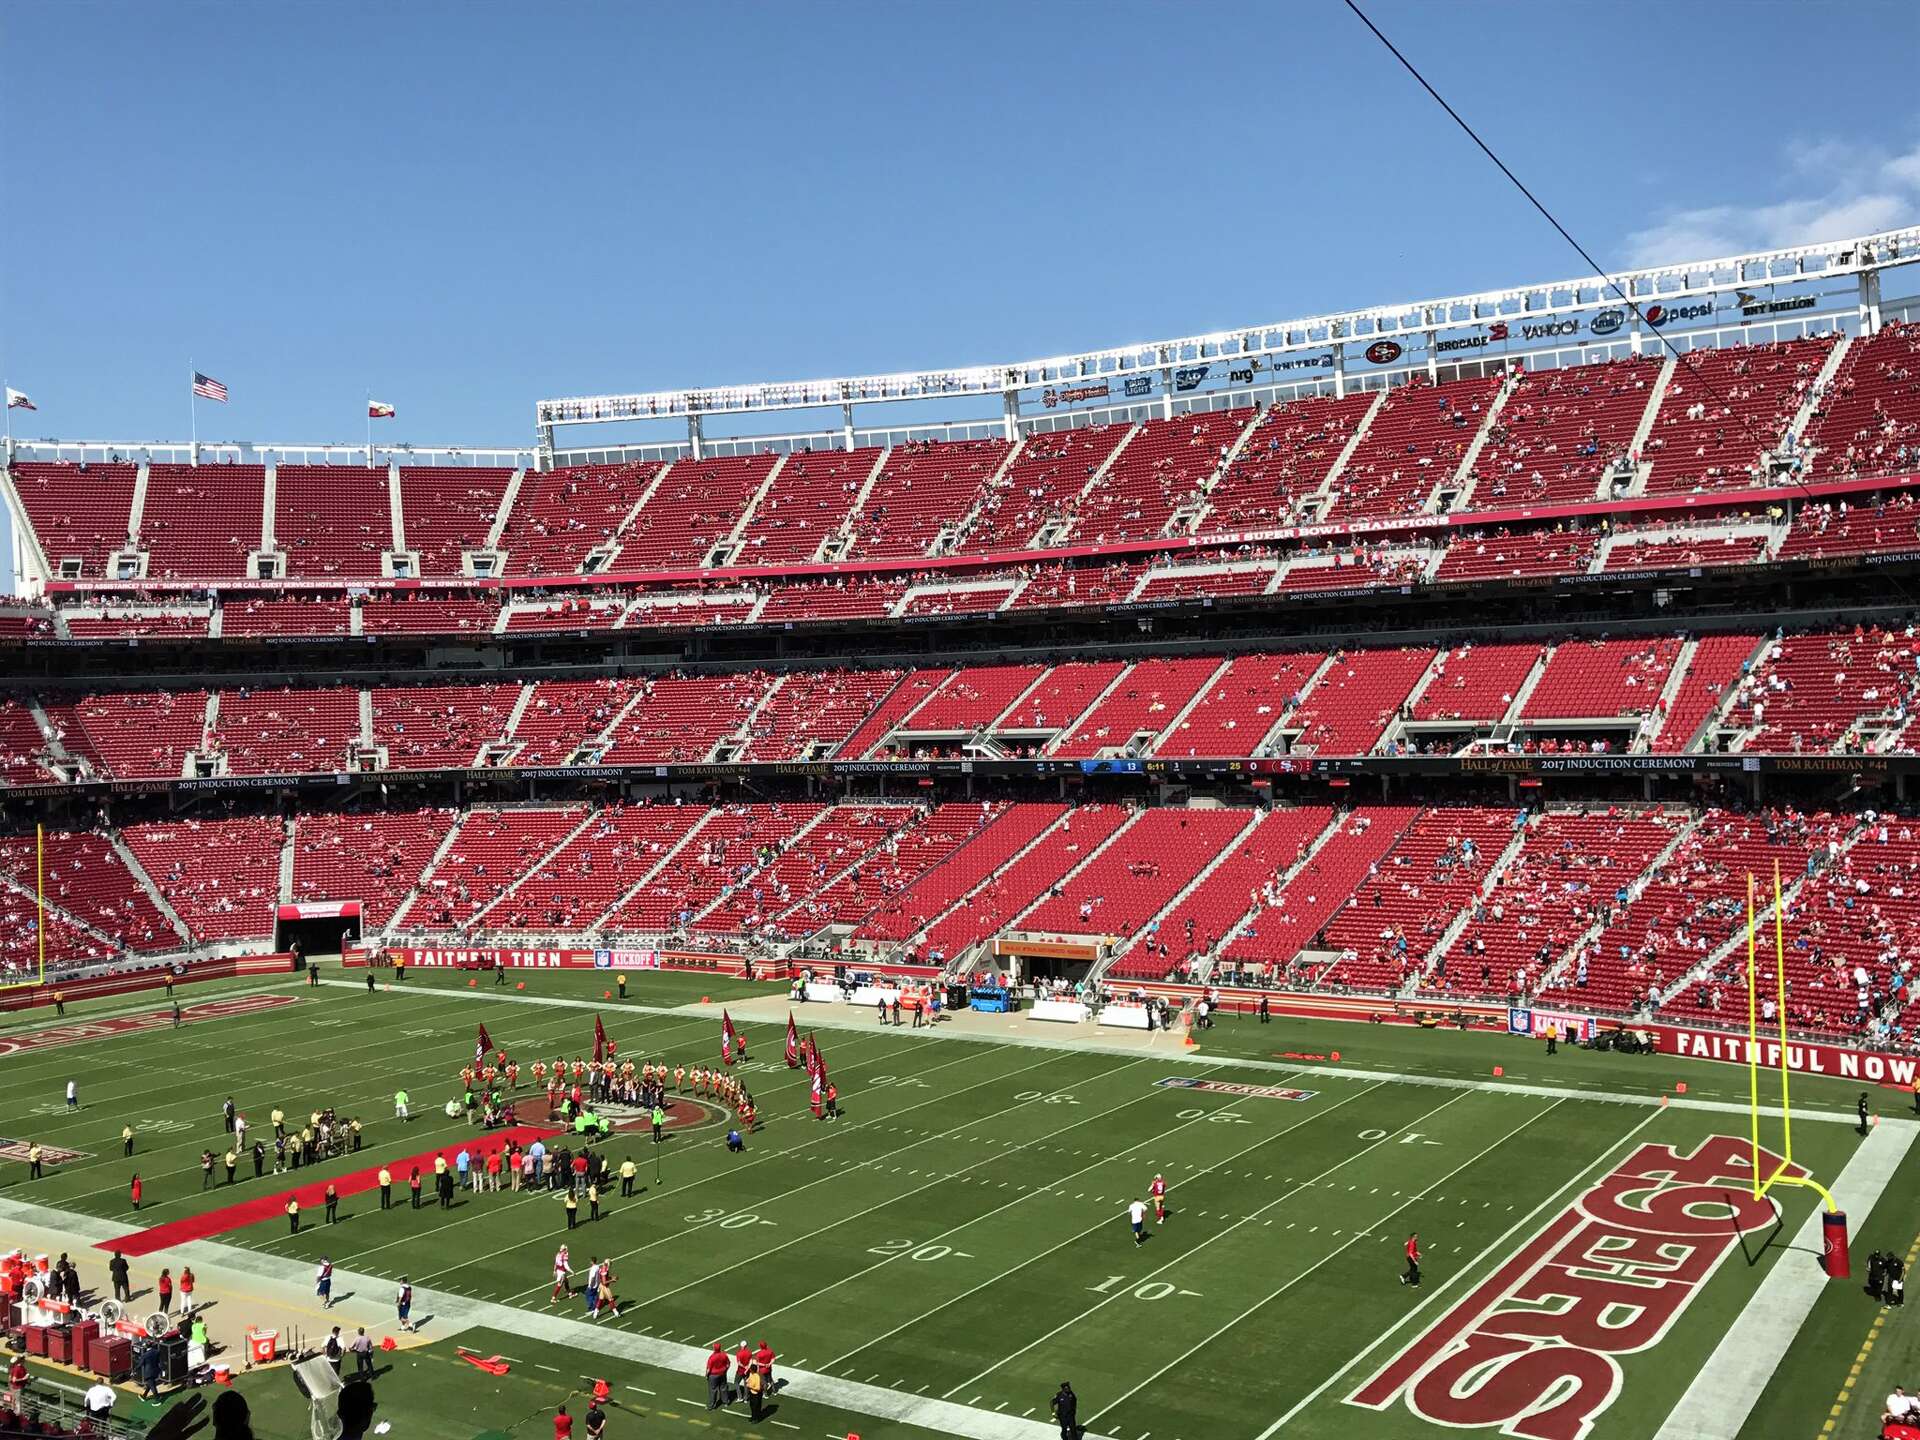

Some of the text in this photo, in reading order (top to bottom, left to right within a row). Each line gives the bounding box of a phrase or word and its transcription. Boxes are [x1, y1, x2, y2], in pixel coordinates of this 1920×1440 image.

[1669, 301, 1713, 323] pepsi
[1743, 298, 1816, 316] BNY MELLON
[1522, 319, 1579, 341] YAHOO!
[1437, 336, 1488, 352] BROCADE
[1274, 359, 1319, 371] UNITED
[1176, 373, 1202, 388] SAP
[1230, 369, 1253, 382] nrg
[1128, 379, 1146, 388] BUD
[1126, 387, 1150, 396] LIGHT
[1189, 516, 1449, 546] 5-TIME SUPER BOWL CHAMPIONS
[1809, 560, 1829, 569] HALL
[1865, 556, 1882, 565] 2017
[1559, 577, 1575, 585] 2017
[1575, 574, 1617, 583] INDUCTION
[1617, 571, 1659, 581] CEREMONY
[159, 582, 198, 590] "SUPPORT"
[316, 580, 344, 588] HOTLINE
[1303, 591, 1339, 599] INDUCTION
[1339, 588, 1375, 597] CEREMONY
[1117, 603, 1149, 611] INDUCTION
[1150, 601, 1180, 609] CEREMONY
[915, 615, 941, 623] INDUCTION
[941, 614, 969, 622] CEREMONY
[735, 623, 764, 631] CEREMONY
[39, 640, 70, 648] INDUCTION
[70, 640, 104, 648] CEREMONY
[677, 767, 696, 776] TOM
[697, 766, 735, 775] RATHMAN
[775, 764, 797, 774] HALL
[804, 765, 828, 774] FAME
[833, 764, 849, 773] 2017
[849, 763, 889, 772] INDUCTION
[890, 763, 930, 772] CEREMONY
[1127, 762, 1136, 771] 13
[1147, 763, 1165, 771] 6:11
[1250, 762, 1257, 770] 0
[1460, 759, 1489, 770] HALL
[1502, 760, 1533, 770] FAME
[1541, 760, 1565, 772] 2017
[1567, 759, 1632, 770] INDUCTION
[1633, 758, 1697, 769] CEREMONY
[1775, 759, 1803, 770] TOM
[1804, 759, 1863, 770] RATHMAN
[1869, 760, 1888, 770] #44
[361, 775, 382, 783] TOM
[382, 774, 425, 782] RATHMAN
[466, 770, 487, 779] HALL
[494, 769, 514, 779] FAME
[521, 771, 537, 779] 2017
[538, 768, 581, 777] INDUCTION
[581, 767, 624, 777] CEREMONY
[7, 789, 27, 798] TOM
[27, 786, 70, 797] RATHMAN
[110, 783, 133, 793] HALL
[145, 782, 171, 792] FAME
[178, 781, 197, 791] 2017
[199, 779, 250, 789] INDUCTION
[250, 777, 300, 787] CEREMONY
[511, 952, 562, 967] THEN
[613, 953, 651, 965] KICKOFF
[1677, 1032, 1917, 1084] FAITHFUL NOW
[1204, 1082, 1295, 1097] KICKOFF
[684, 1208, 762, 1229] 30
[866, 1238, 953, 1262] 20
[1085, 1276, 1176, 1300] 10
[1340, 1134, 1814, 1440] 49ERS
[258, 1342, 270, 1355] G
